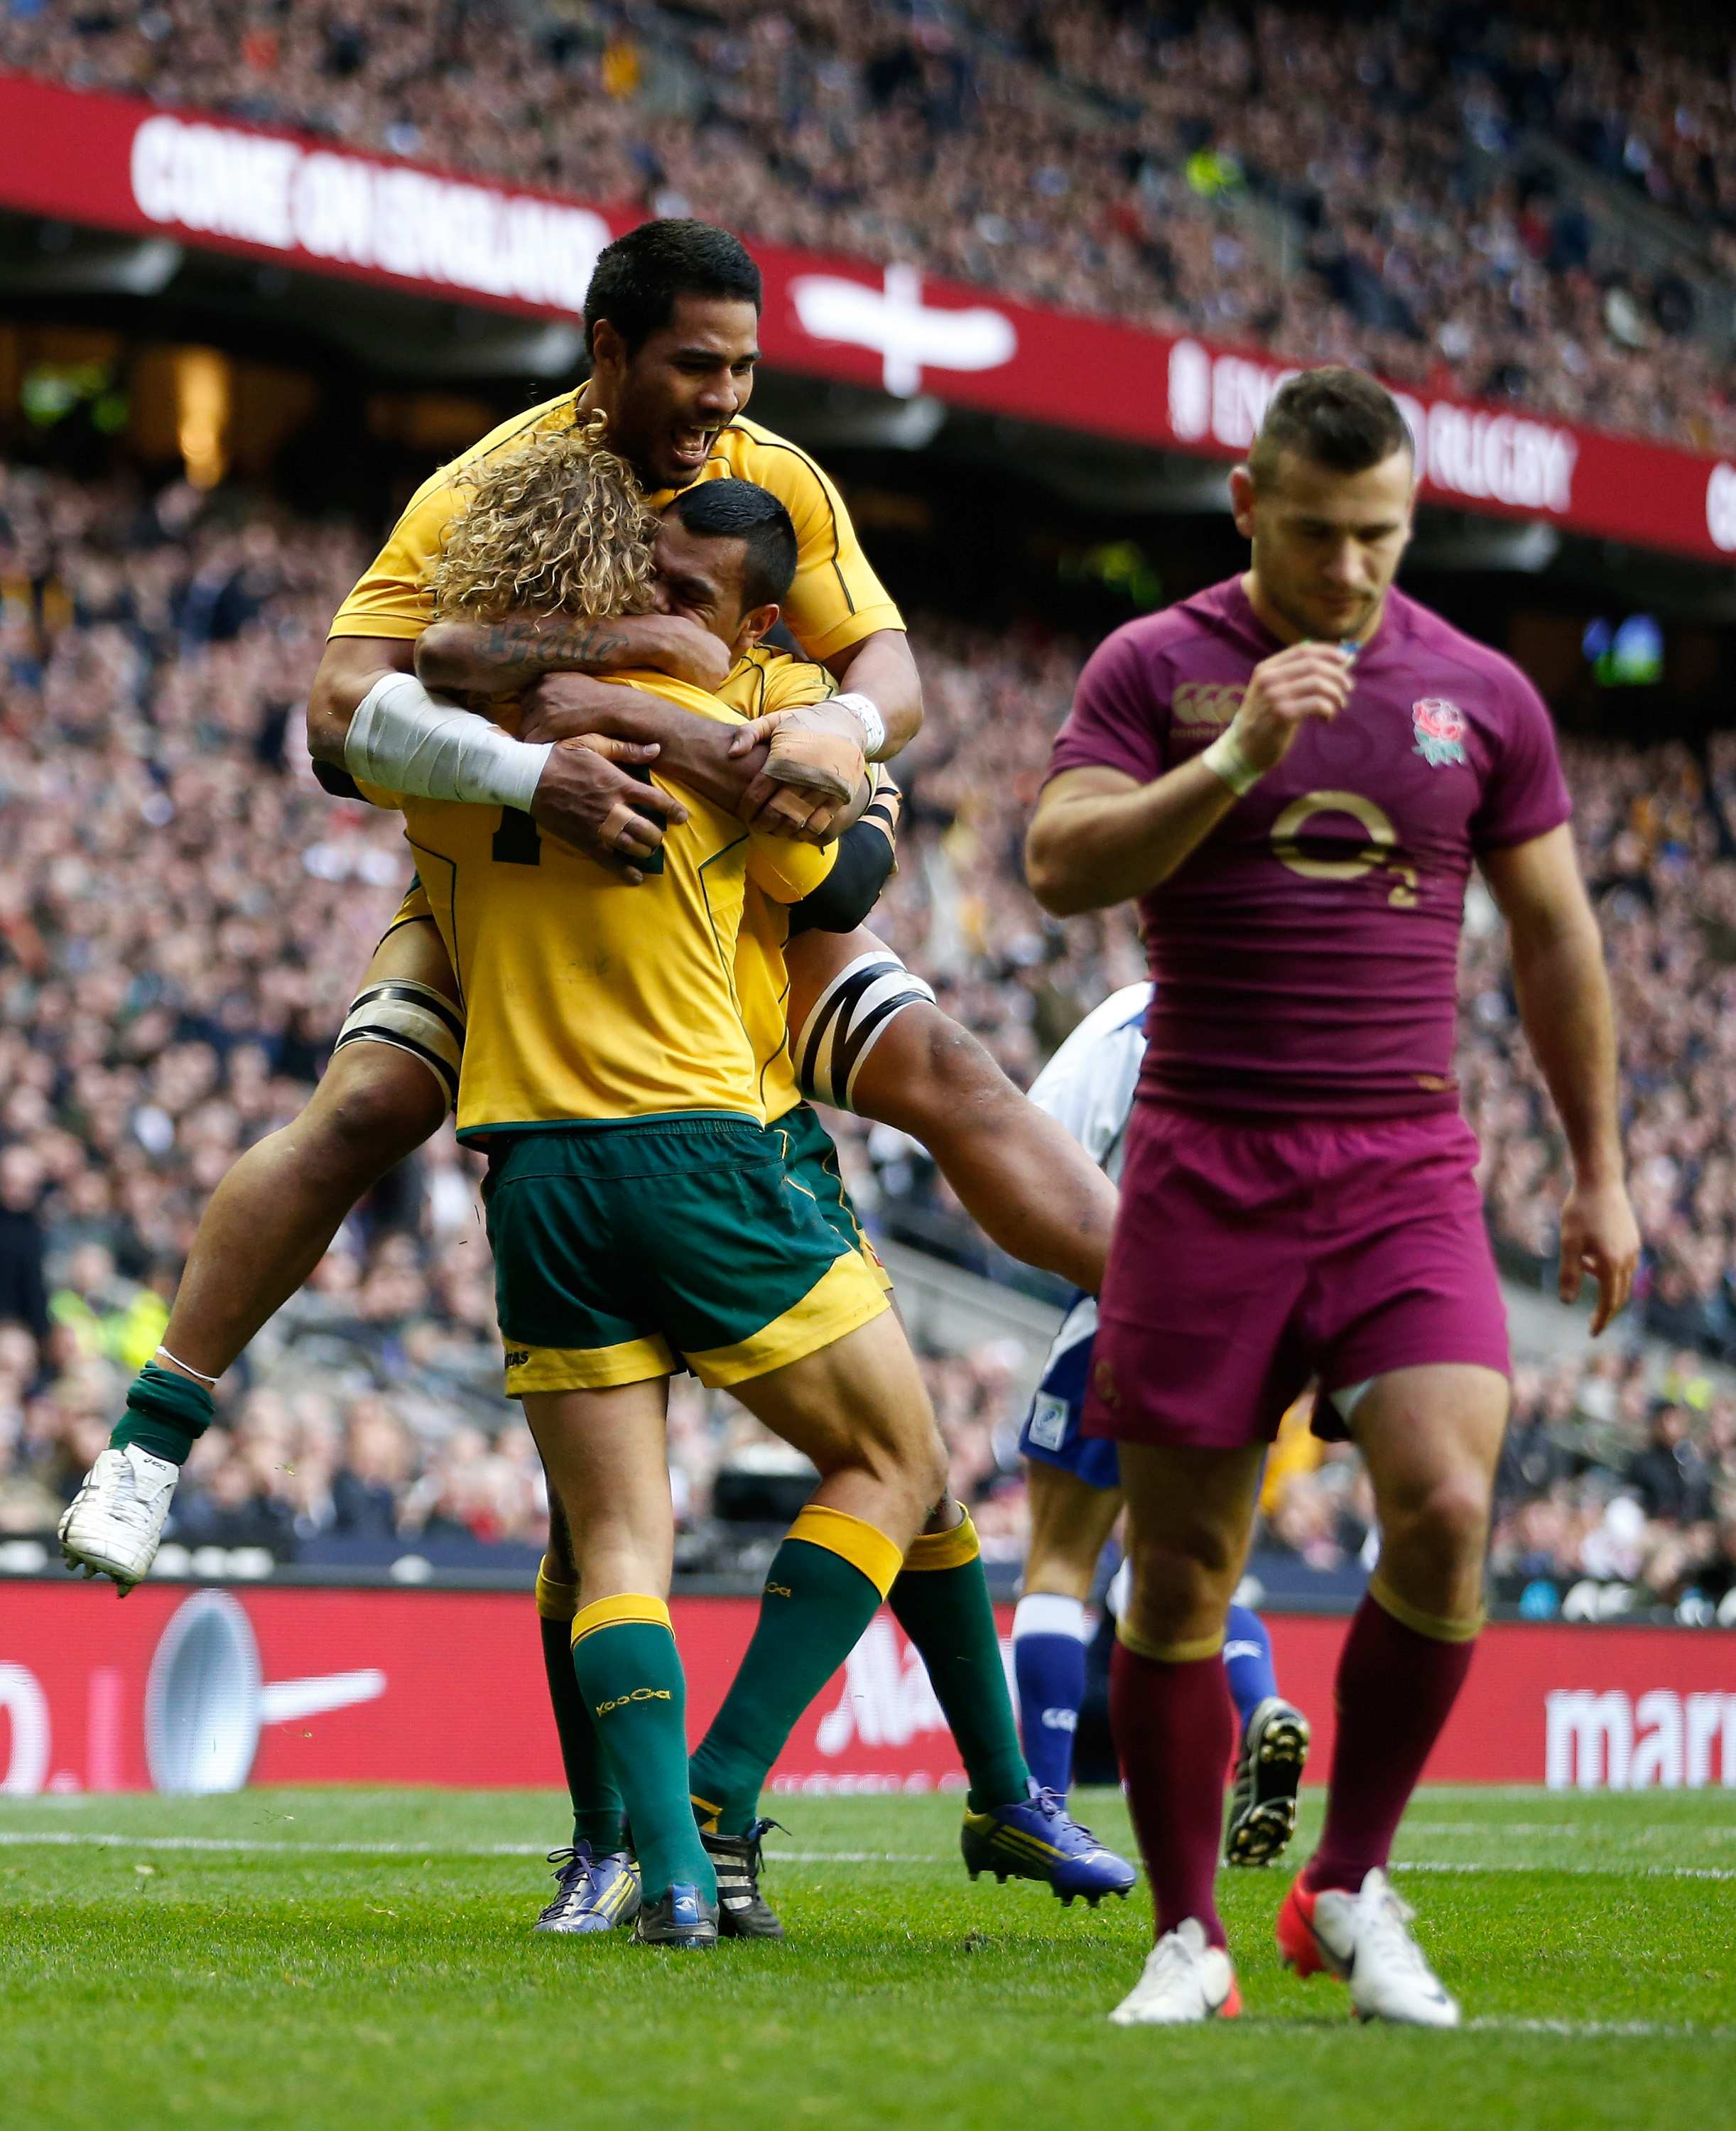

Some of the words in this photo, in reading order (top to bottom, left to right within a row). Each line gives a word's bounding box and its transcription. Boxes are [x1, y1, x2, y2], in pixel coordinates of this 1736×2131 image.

[131, 115, 298, 250] COME
[294, 151, 374, 267] ON
[1426, 402, 1578, 513] RUGBY
